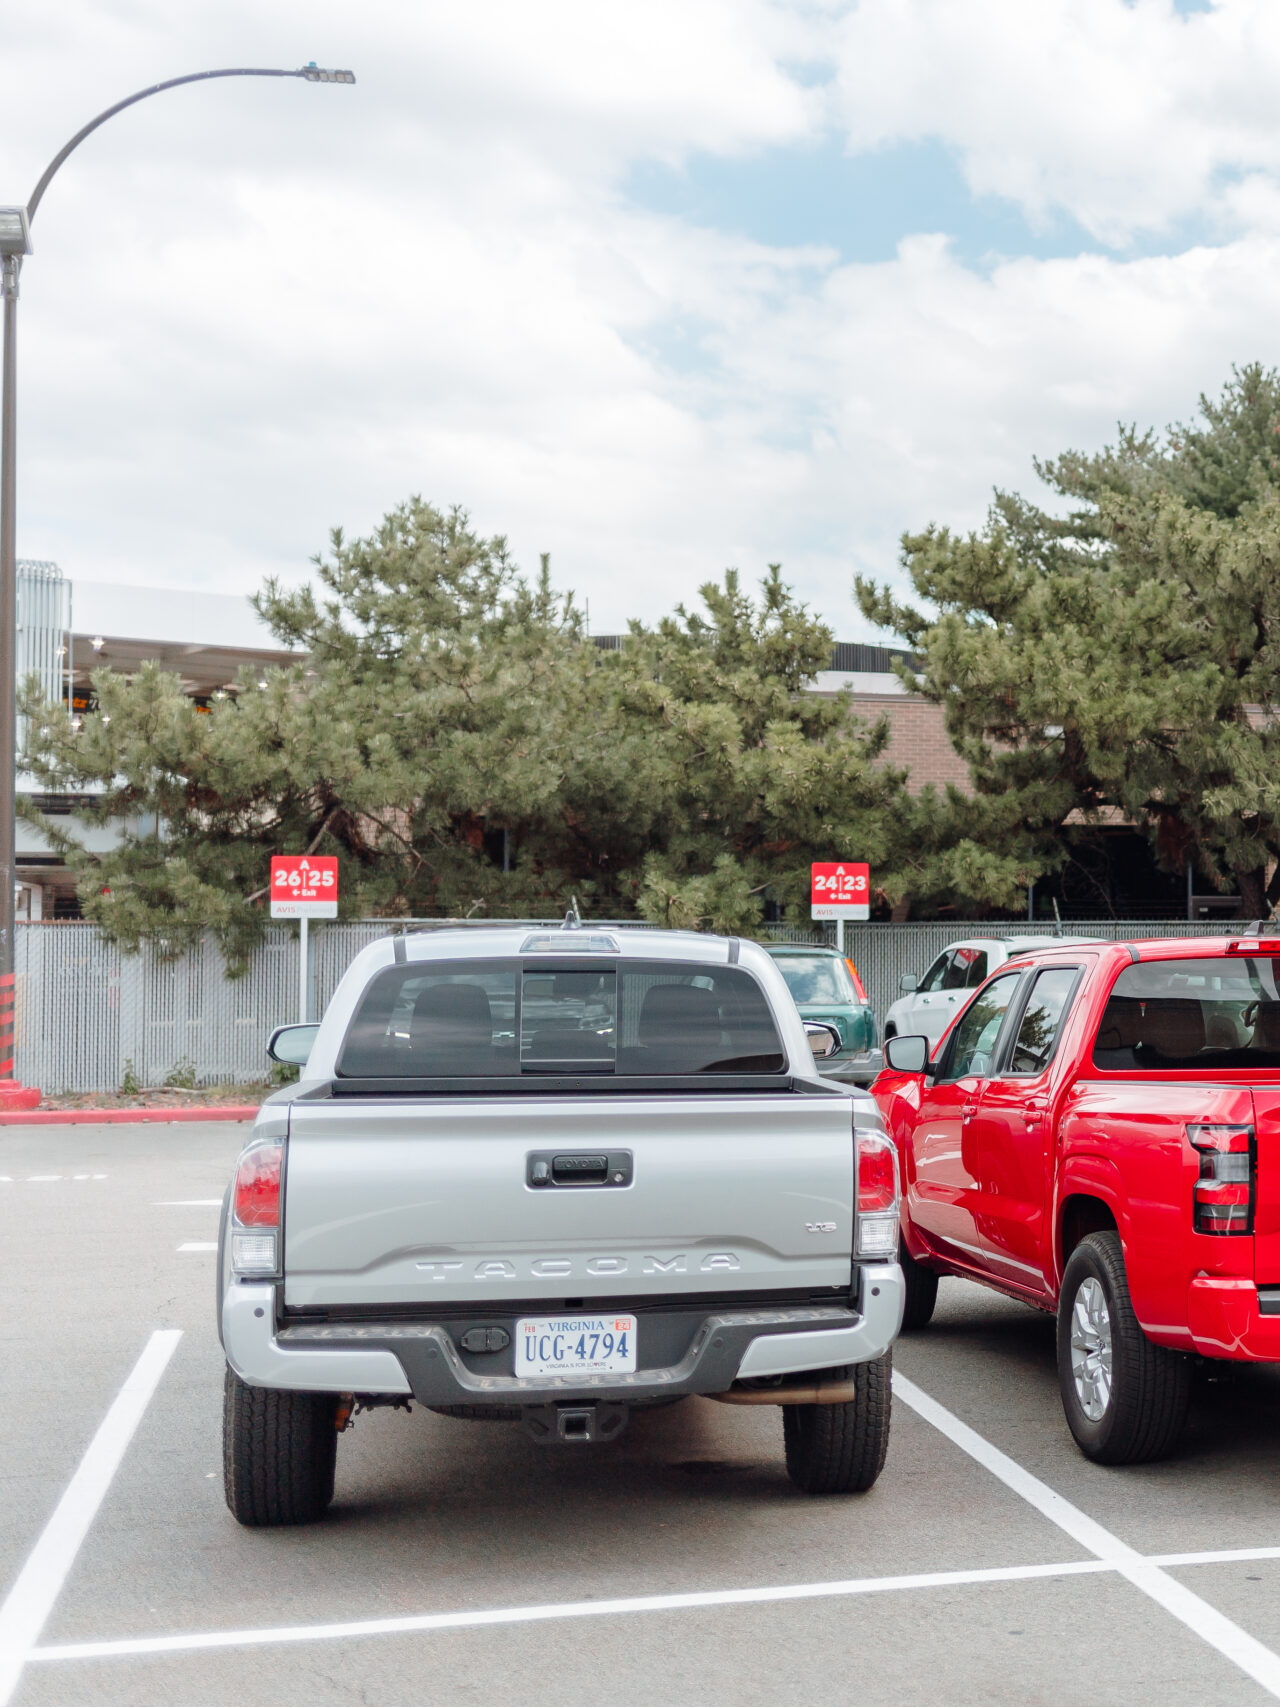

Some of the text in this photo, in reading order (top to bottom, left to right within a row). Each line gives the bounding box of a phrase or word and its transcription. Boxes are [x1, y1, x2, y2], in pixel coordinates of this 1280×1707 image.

[299, 859, 310, 870] A
[836, 865, 846, 875] A
[275, 870, 335, 887] 26 25
[814, 875, 867, 891] 24 23
[804, 1221, 838, 1233] V6
[415, 1252, 741, 1281] TACOMA
[547, 1320, 605, 1333] VIRGINIA
[525, 1332, 629, 1362] UCG-4794
